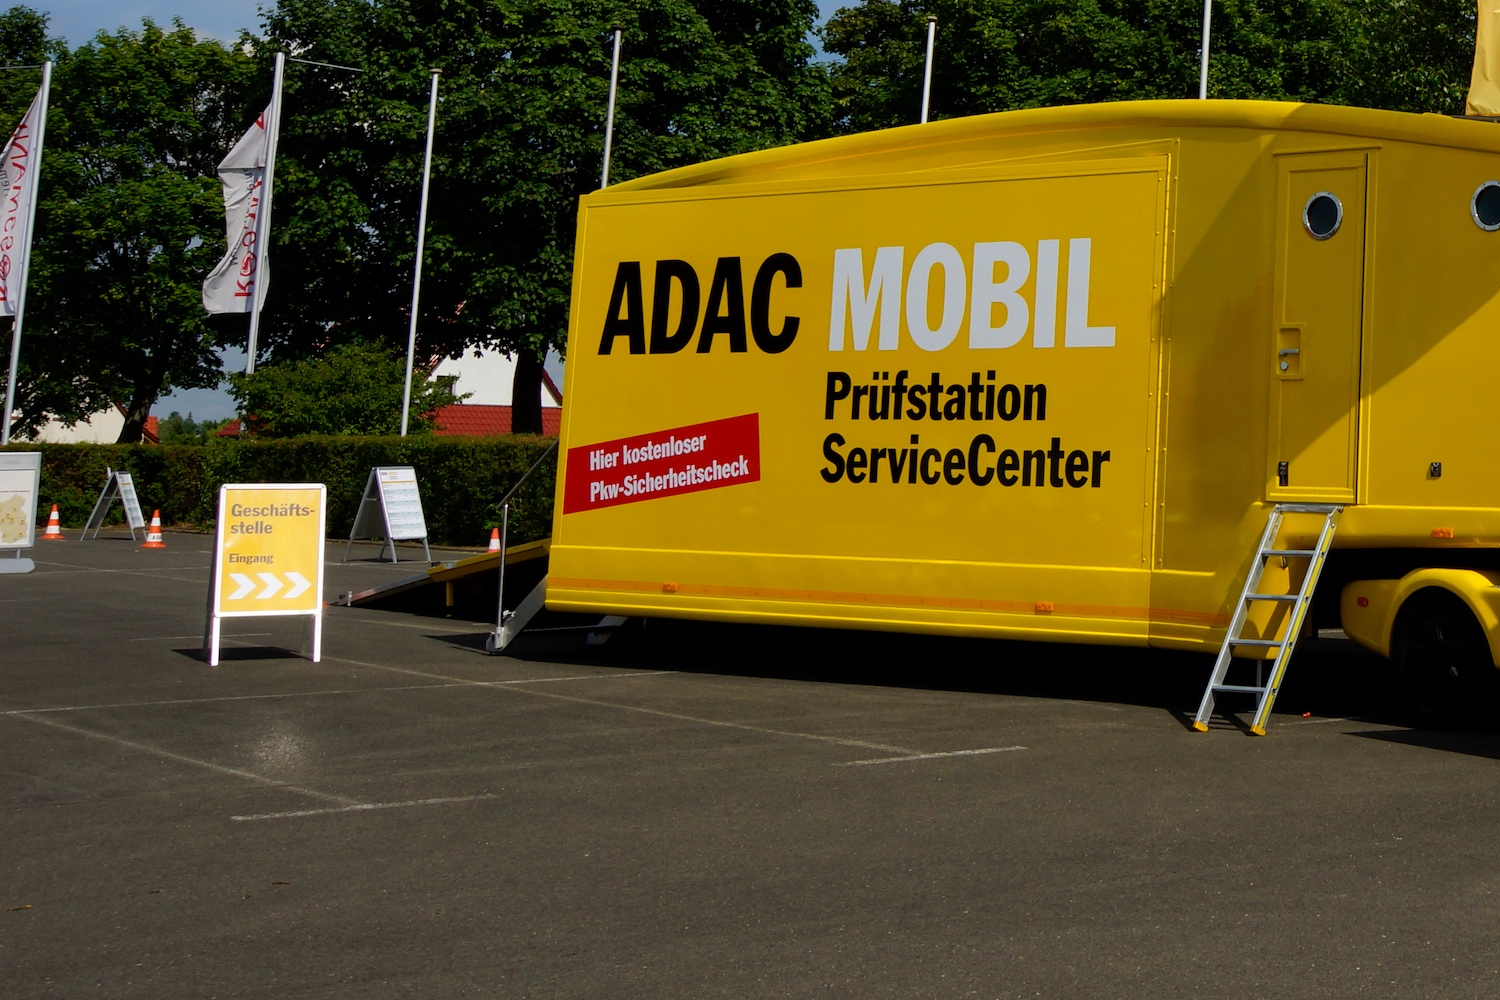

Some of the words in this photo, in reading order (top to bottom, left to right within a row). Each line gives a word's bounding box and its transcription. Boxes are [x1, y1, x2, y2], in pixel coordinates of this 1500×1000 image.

[597, 252, 803, 355] ADAC
[828, 237, 1116, 352] MOBIL
[824, 369, 1047, 422] Prüfstation
[589, 449, 619, 471] Hier
[623, 434, 707, 465] kostenloser
[820, 432, 1110, 488] ServiceCenter
[590, 455, 750, 502] Pkw-Sicherheitscheck
[230, 521, 273, 534] stelle
[231, 503, 315, 517] Geschäfts-
[229, 553, 274, 565] Eingang
